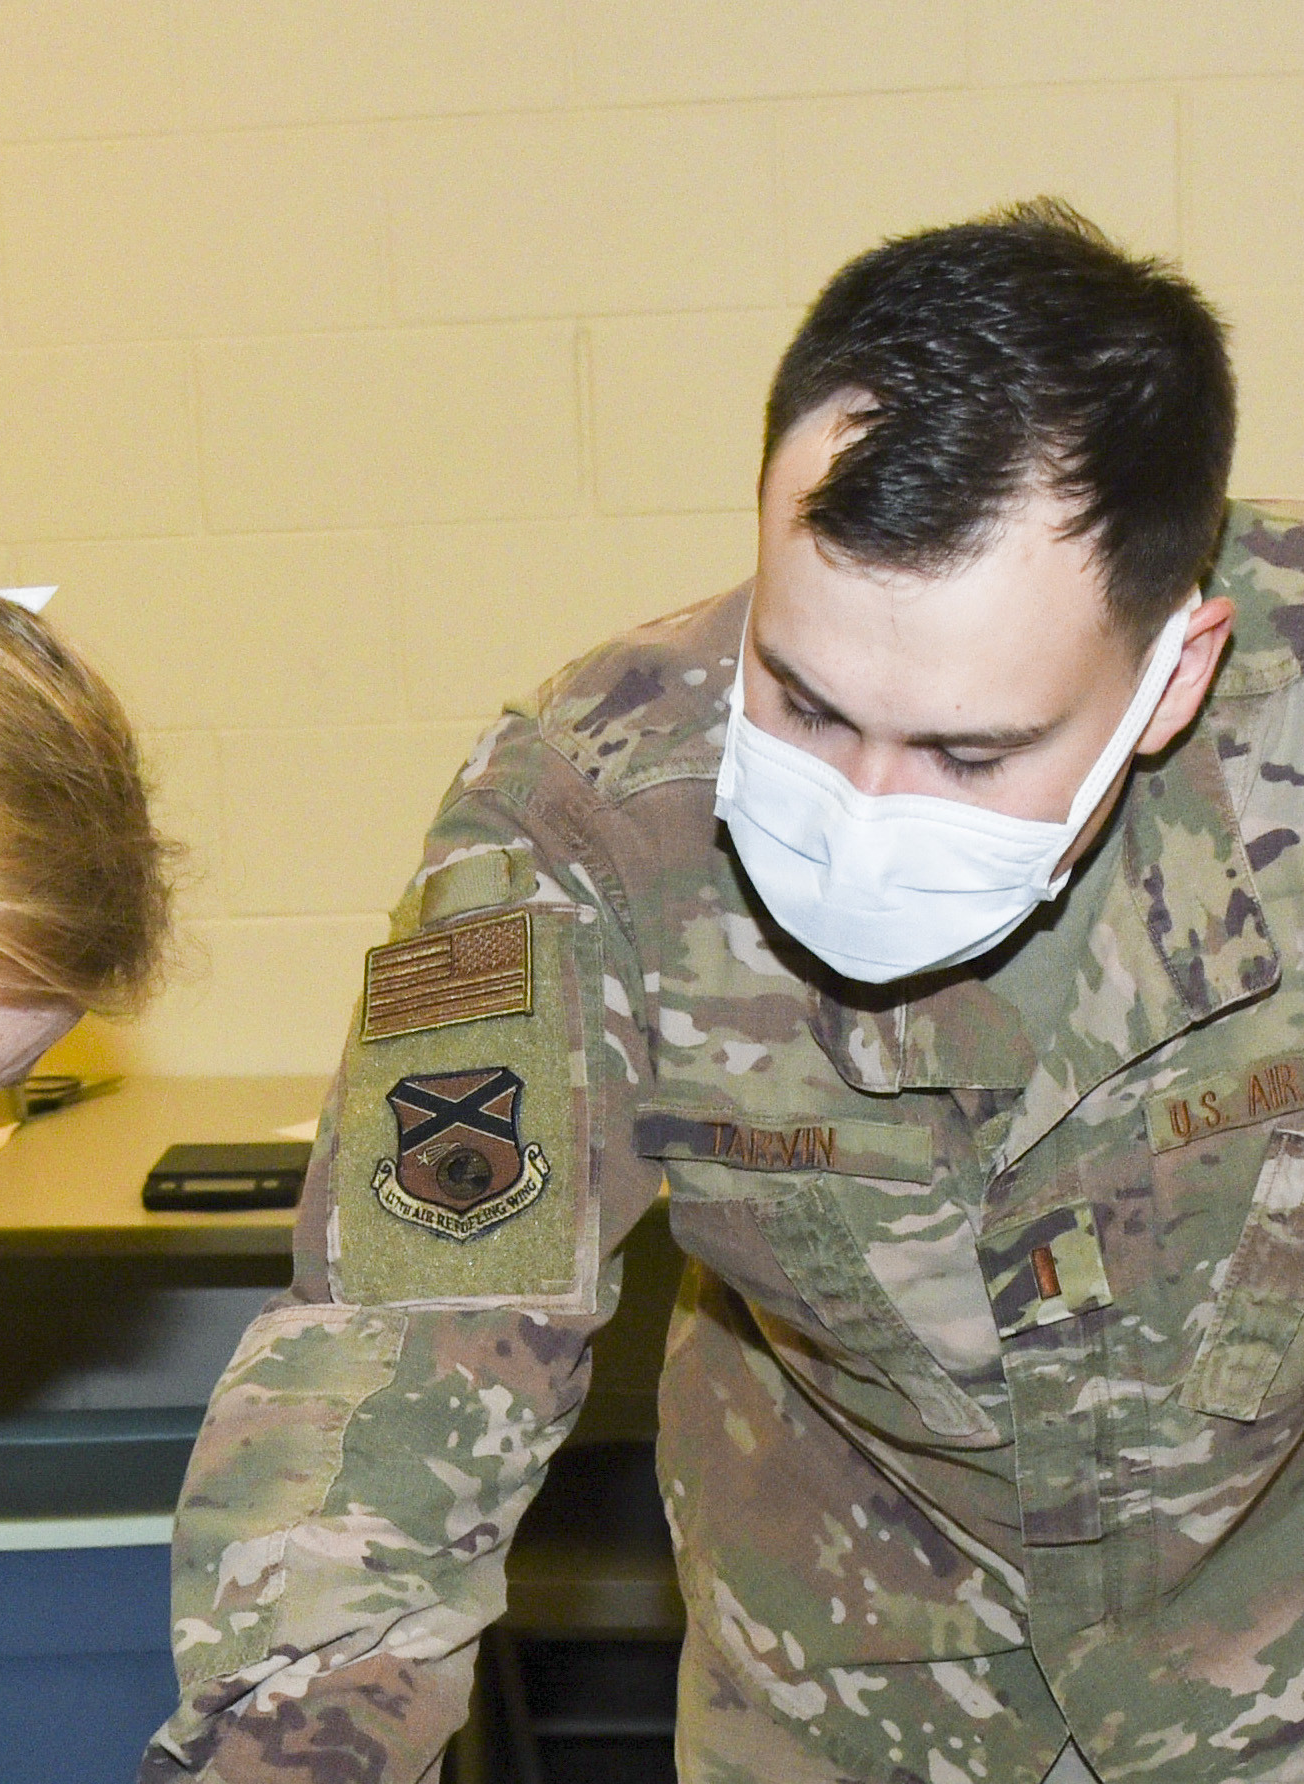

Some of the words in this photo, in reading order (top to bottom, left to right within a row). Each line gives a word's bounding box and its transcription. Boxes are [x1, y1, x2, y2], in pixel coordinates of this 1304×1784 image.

[1170, 1090, 1231, 1138] U.S.
[1247, 1062, 1299, 1117] AIR
[708, 1119, 836, 1169] TARVIN
[411, 1207, 434, 1223] AIR
[437, 1201, 507, 1233] REFUELING
[506, 1178, 537, 1209] WING
